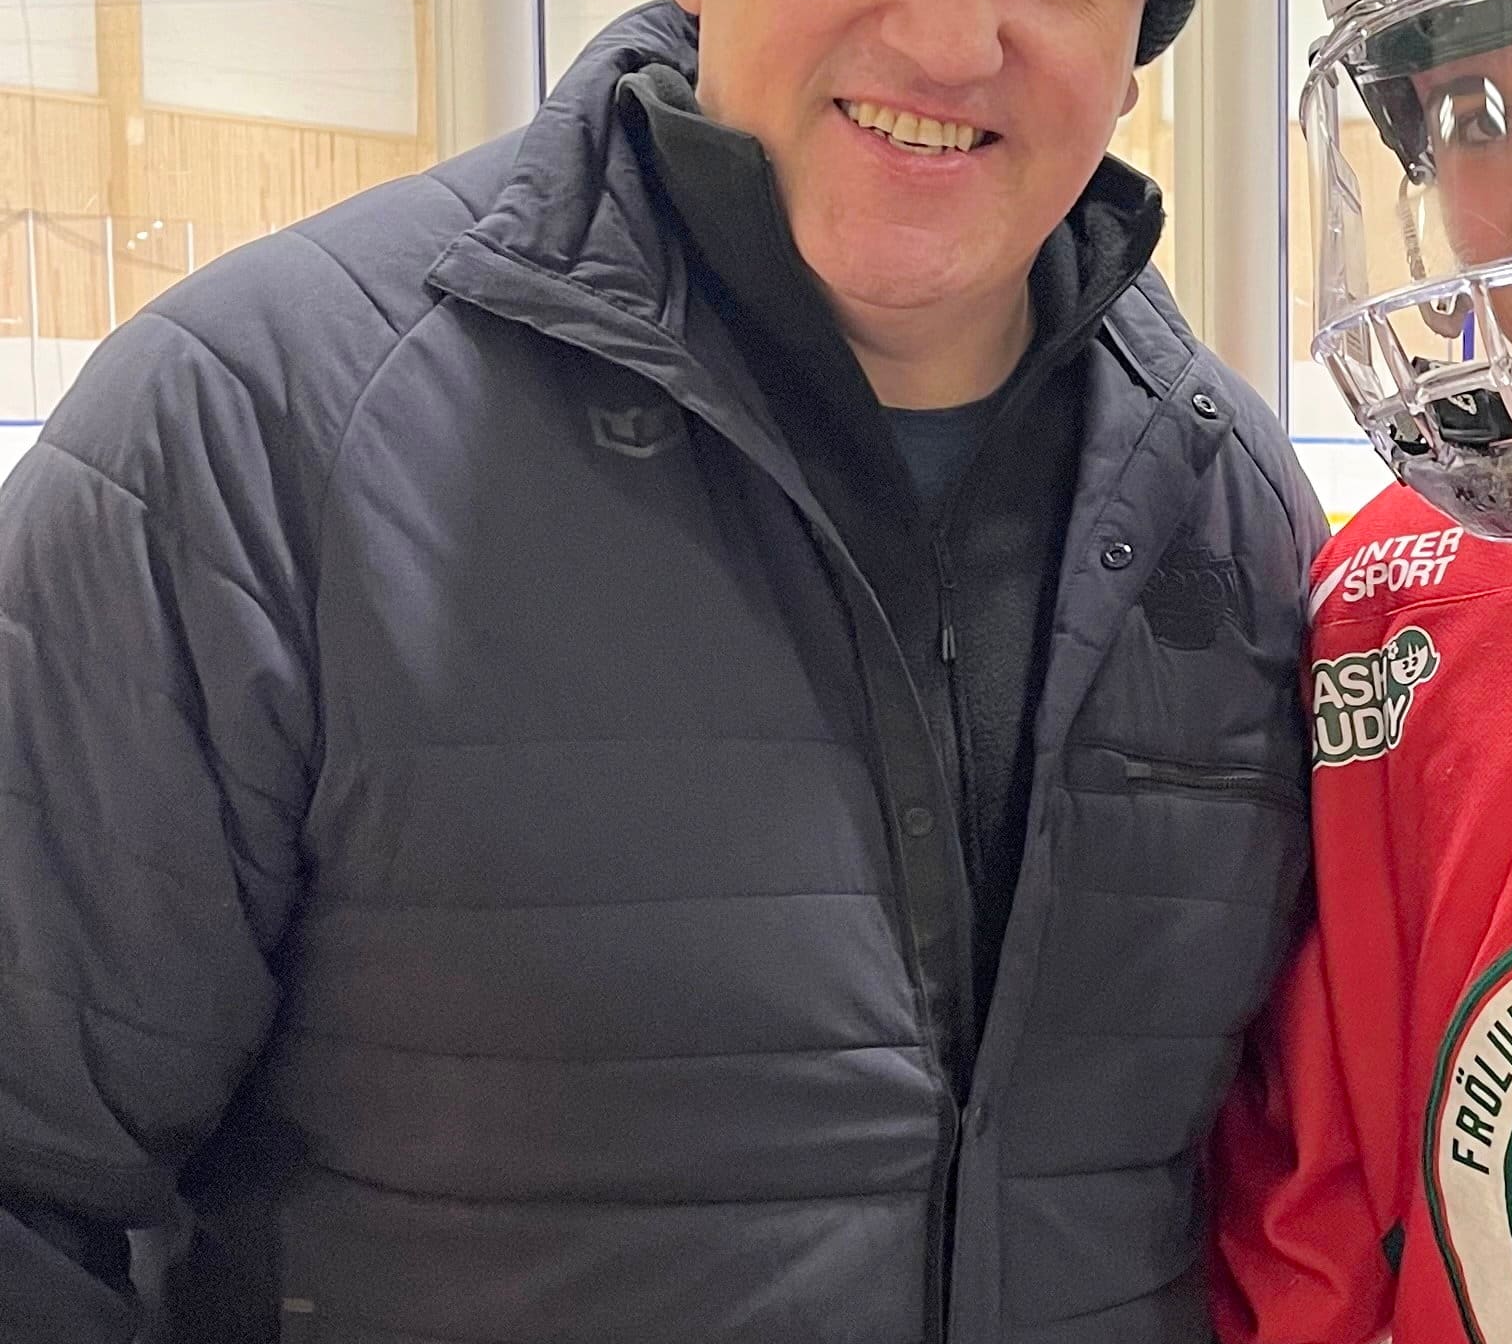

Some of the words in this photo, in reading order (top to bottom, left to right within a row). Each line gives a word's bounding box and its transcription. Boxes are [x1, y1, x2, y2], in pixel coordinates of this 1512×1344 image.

[1350, 526, 1464, 571] INTER
[1342, 555, 1457, 602] SPORT
[1313, 655, 1389, 715] ASH
